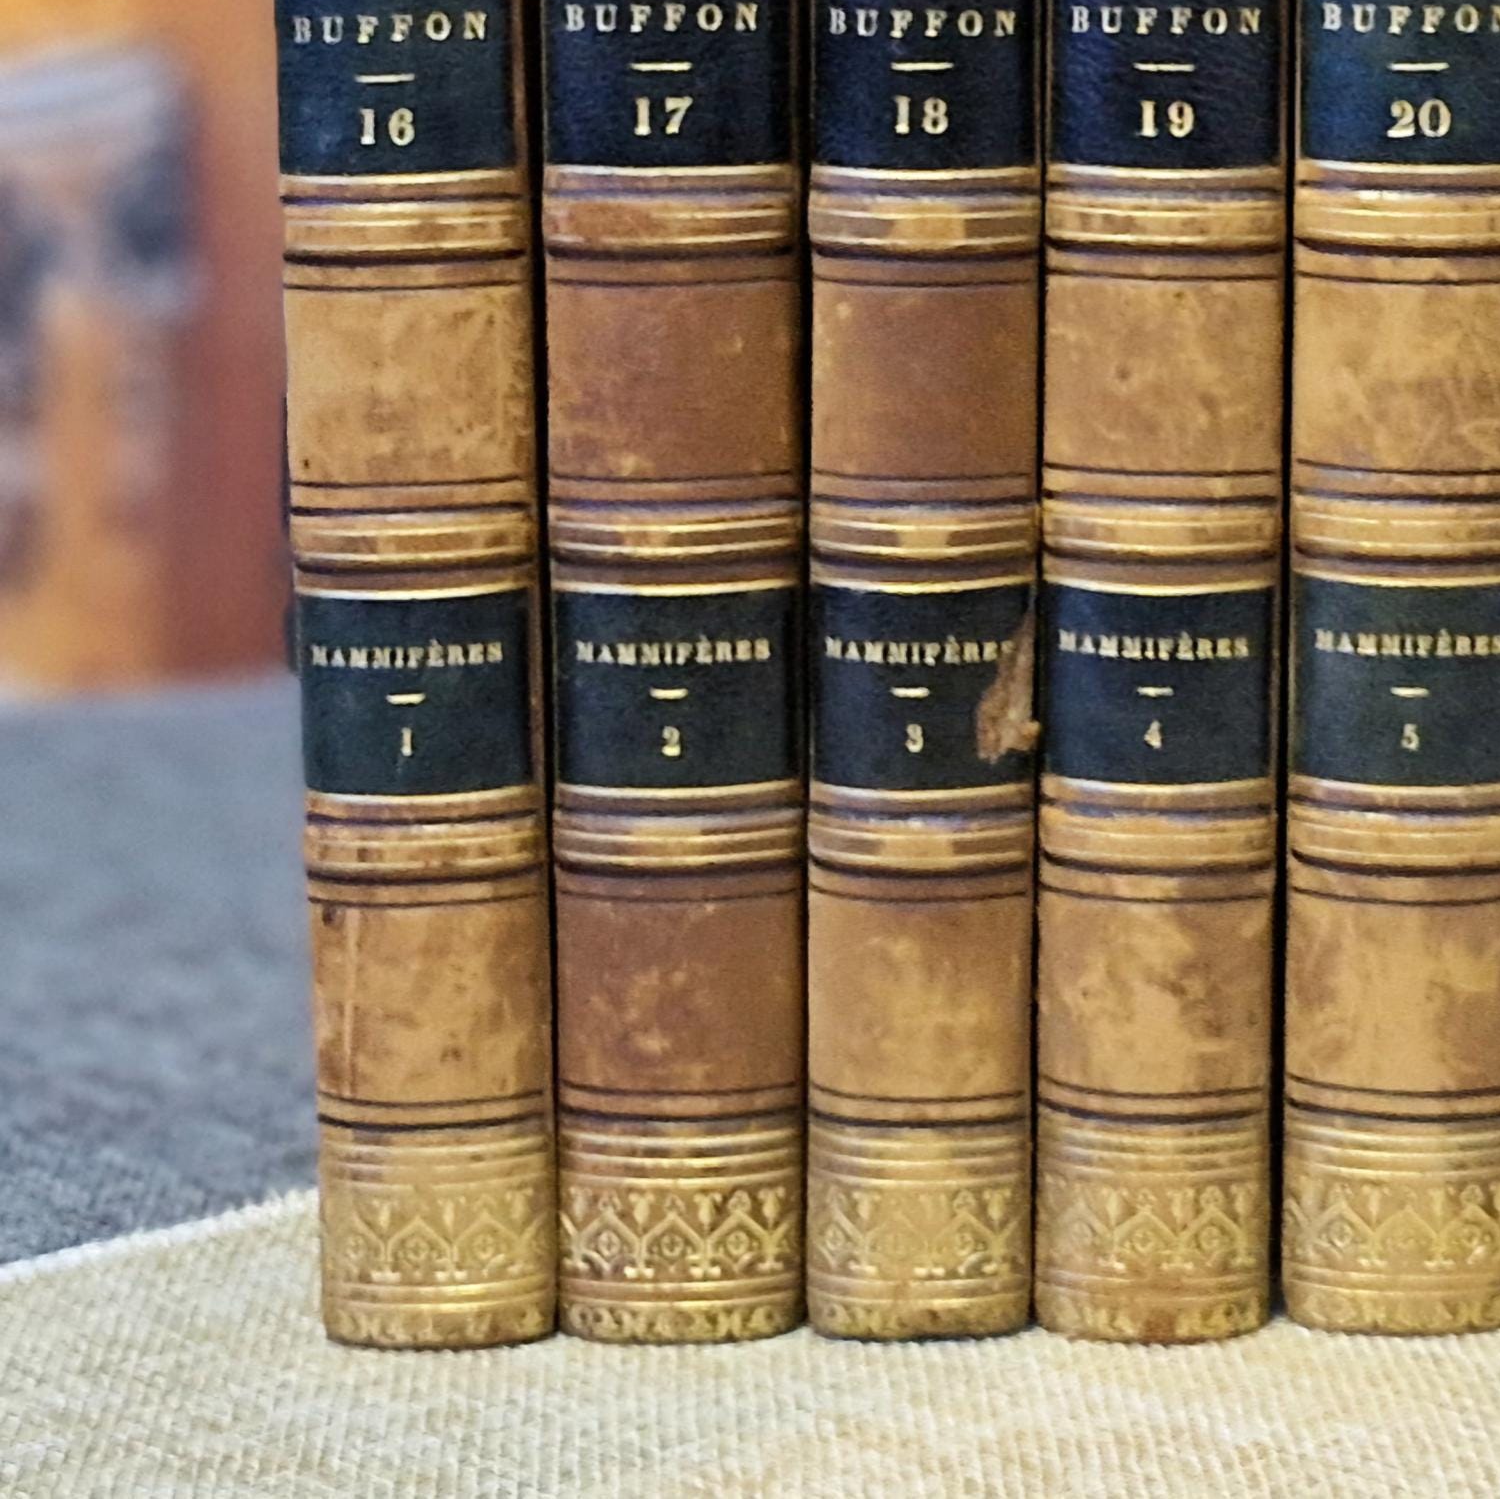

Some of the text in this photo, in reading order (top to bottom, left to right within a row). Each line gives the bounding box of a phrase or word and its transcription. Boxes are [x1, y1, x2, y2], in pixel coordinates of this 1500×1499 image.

[293, 11, 487, 45] BUFFON
[565, 3, 758, 33] BUFFON
[829, 6, 1016, 38] BUFFON
[1070, 5, 1261, 35] BUFFON
[359, 107, 415, 146] 16
[634, 97, 693, 135] 17
[894, 96, 949, 135] 18
[1139, 101, 1195, 138] 19
[1386, 98, 1452, 138] 20
[400, 727, 413, 757] 1
[662, 726, 682, 757] 2
[905, 723, 925, 754] 3
[1143, 720, 1163, 750] 4
[1402, 723, 1420, 752] 5
